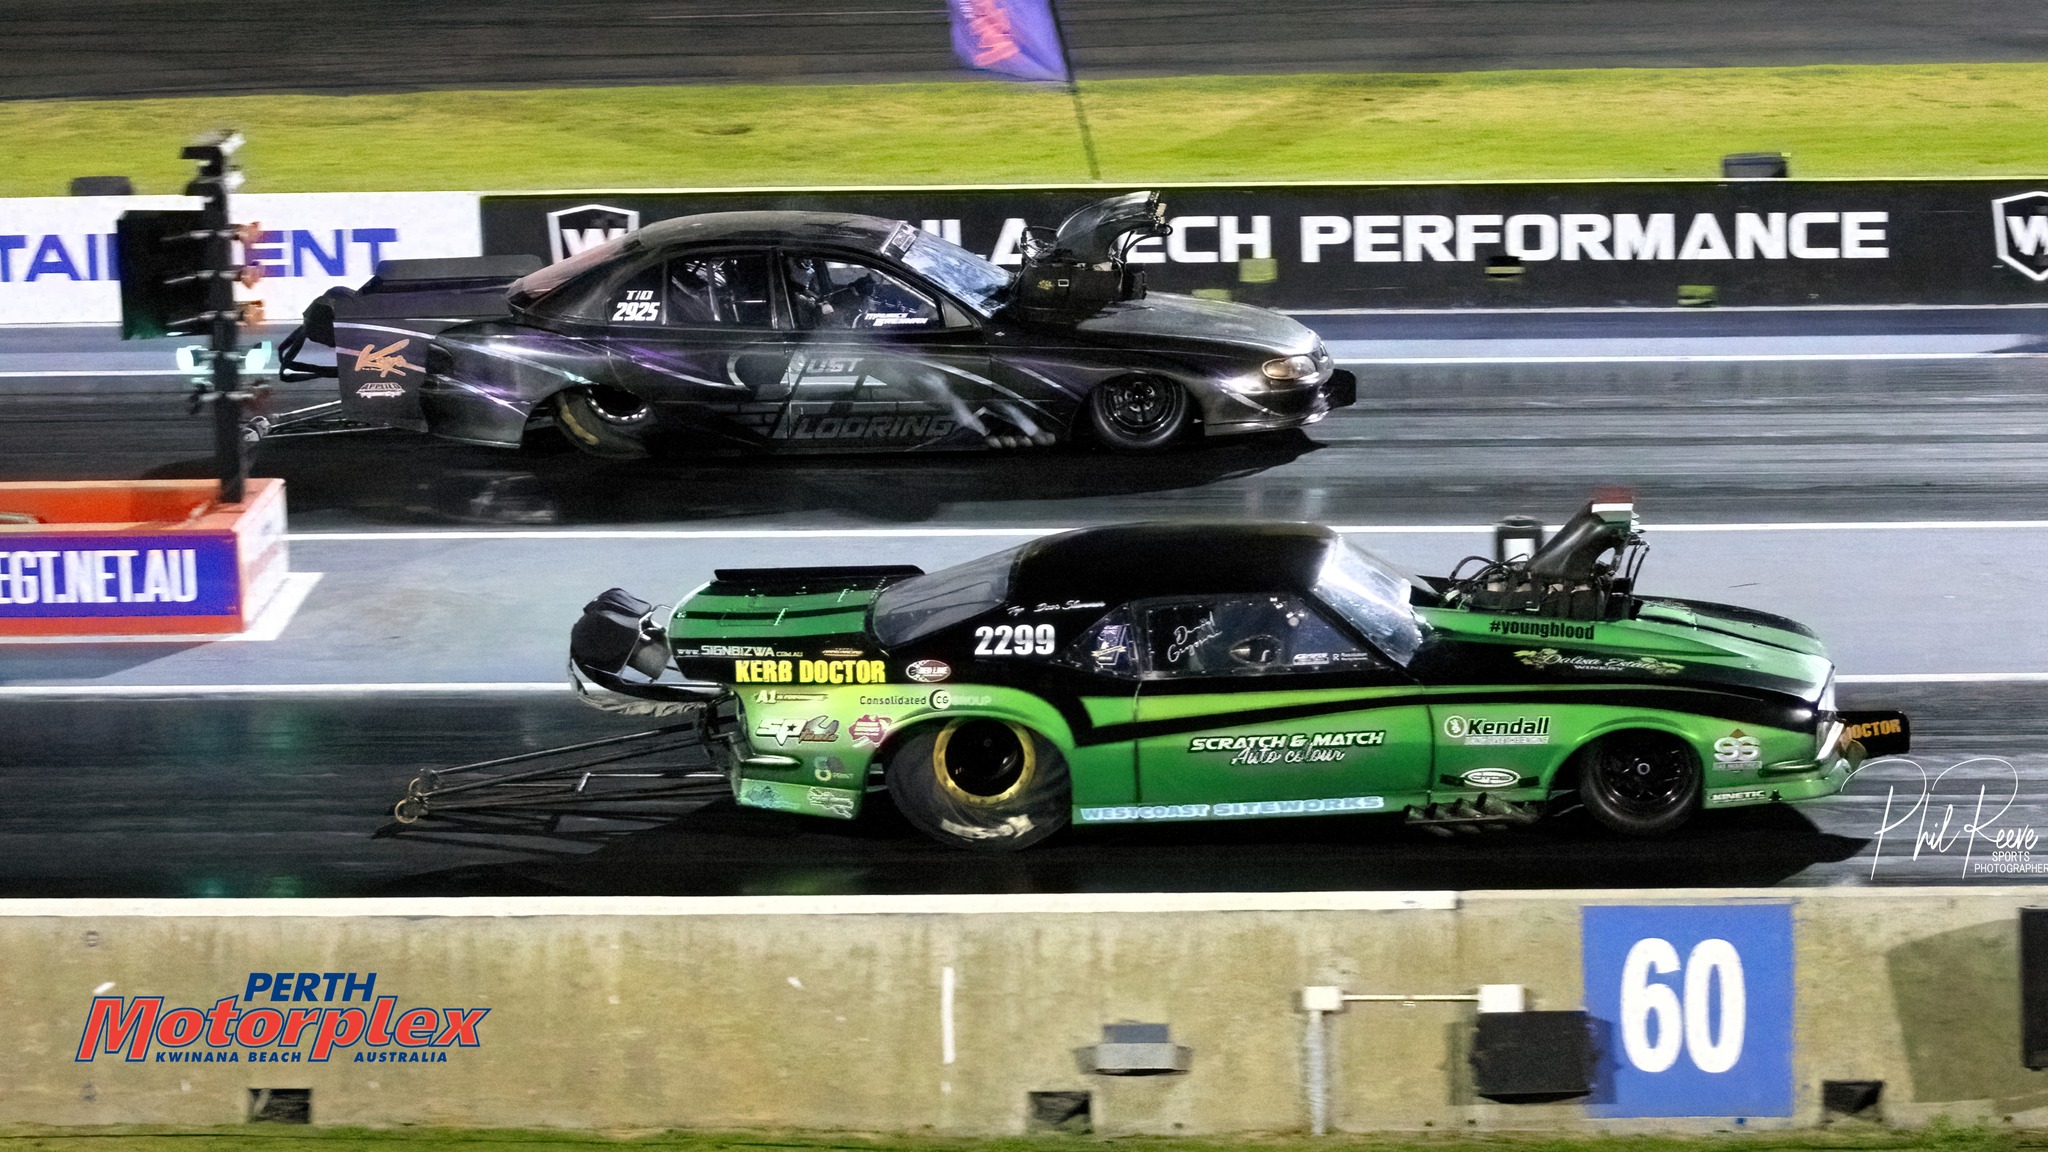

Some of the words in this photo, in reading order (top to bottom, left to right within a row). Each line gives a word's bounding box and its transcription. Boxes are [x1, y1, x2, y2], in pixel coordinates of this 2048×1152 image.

[1300, 211, 1890, 263] PERFORMANCE
[0, 228, 397, 283] TAIENT
[612, 302, 661, 321] 2925
[974, 623, 1056, 656] 2299
[1489, 620, 1595, 640] #youngblood
[735, 660, 793, 683] KERB
[799, 659, 887, 684] DOCTOR
[860, 695, 927, 705] Consolidated
[1468, 717, 1550, 735] Kendall
[1191, 735, 1286, 751] SCRATCH
[1290, 734, 1308, 748] &
[1312, 732, 1385, 746] MATCH
[1231, 747, 1281, 765] Auto
[1081, 804, 1211, 821] WESTCOAST
[1213, 796, 1385, 817] SITEWORKS
[1620, 938, 1747, 1073] 60
